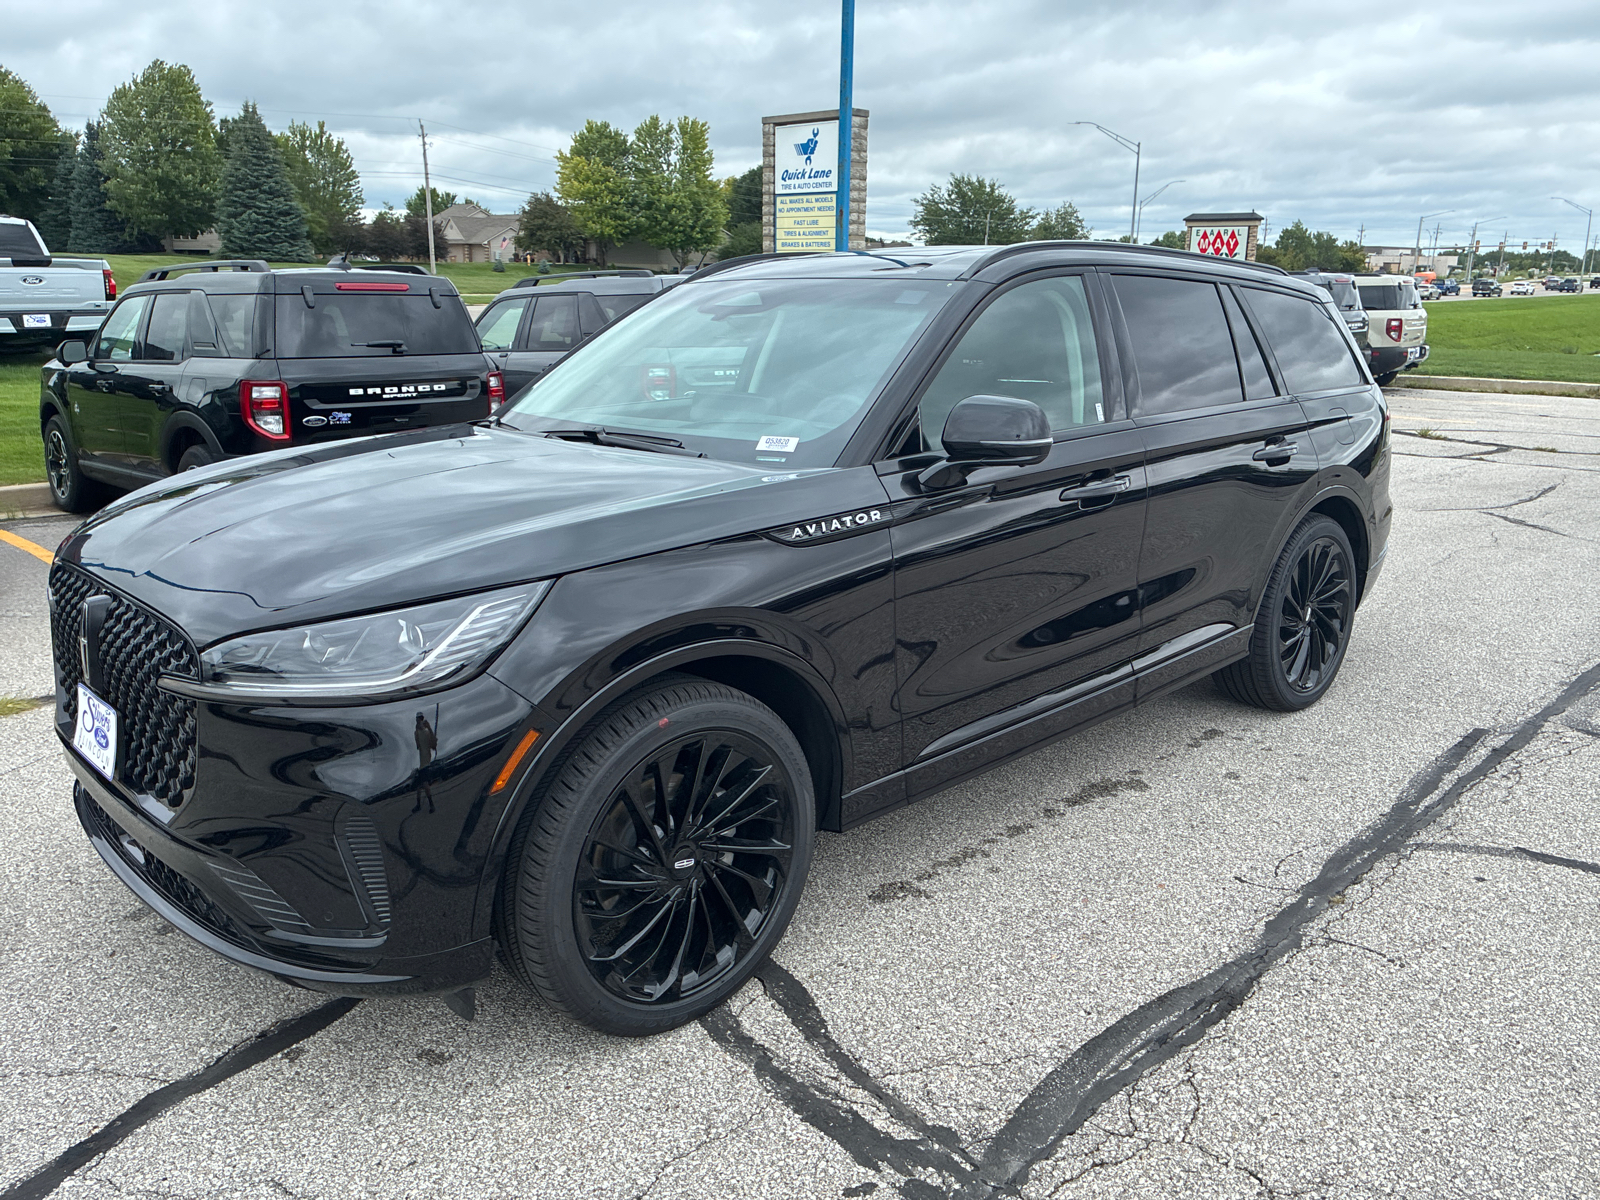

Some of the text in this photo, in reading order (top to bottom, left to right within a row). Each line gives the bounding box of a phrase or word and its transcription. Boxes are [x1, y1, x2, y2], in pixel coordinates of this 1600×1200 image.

[781, 168, 832, 182] Quick Lane
[797, 182, 811, 190] AUTO
[812, 181, 832, 189] CENTER
[1200, 238, 1236, 249] MAY
[349, 384, 446, 395] BRONCO
[791, 510, 881, 539] AVIATOR
